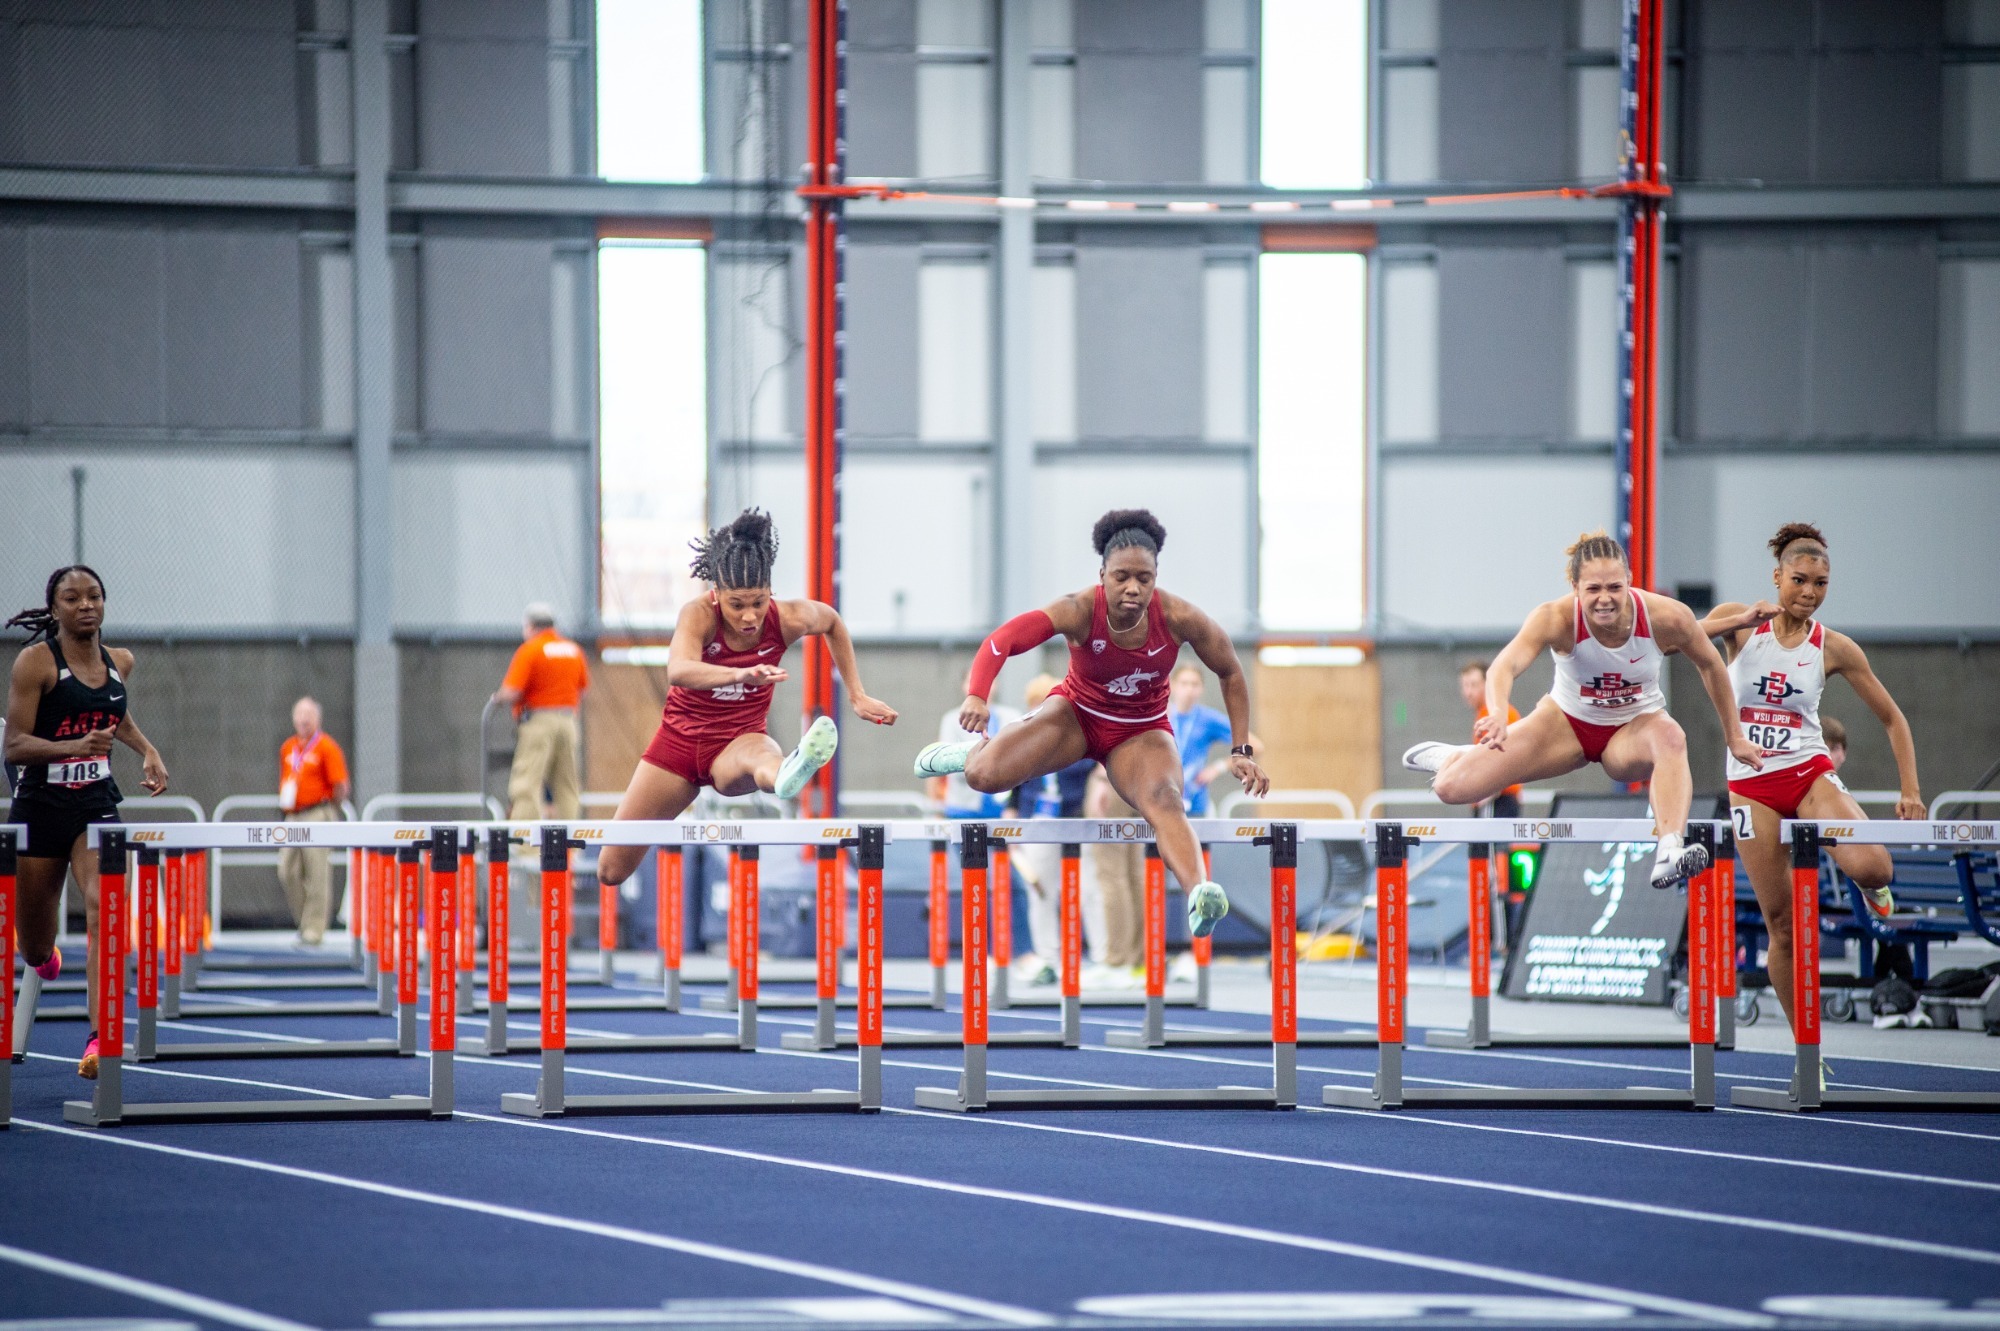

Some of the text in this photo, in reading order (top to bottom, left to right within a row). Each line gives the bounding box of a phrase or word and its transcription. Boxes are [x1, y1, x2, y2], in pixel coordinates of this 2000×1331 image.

[1753, 712, 1790, 724] WSU OPEN
[1748, 724, 1792, 750] 662
[1513, 823, 1528, 838] THE
[1734, 808, 1749, 838] 2
[132, 831, 165, 841] GILL
[247, 827, 262, 842] THE
[394, 829, 425, 840] GILL
[513, 829, 530, 837] GIL
[572, 829, 604, 839] GILL
[682, 826, 697, 840] THE
[822, 828, 852, 838] GILL
[992, 827, 1022, 837] GILL
[1098, 824, 1113, 839] THE
[1235, 827, 1266, 837] GILL
[1407, 826, 1437, 836] GILL
[1823, 827, 1855, 837] GILL
[1932, 825, 1948, 840] THE
[406, 875, 414, 991] SPOKANE
[1722, 872, 1730, 986] SPOKANE
[145, 879, 153, 996] SPOKANE
[440, 888, 449, 1035] SPOKANE
[550, 888, 559, 1034] SPOKANE
[868, 886, 876, 1030] SPOKANE
[973, 885, 981, 1029] SPOKANE
[1281, 884, 1290, 1028] SPOKANE
[1387, 883, 1396, 1027] SPOKANE
[1803, 885, 1813, 1029] SPOKANE
[108, 891, 117, 1041] SPOKANE
